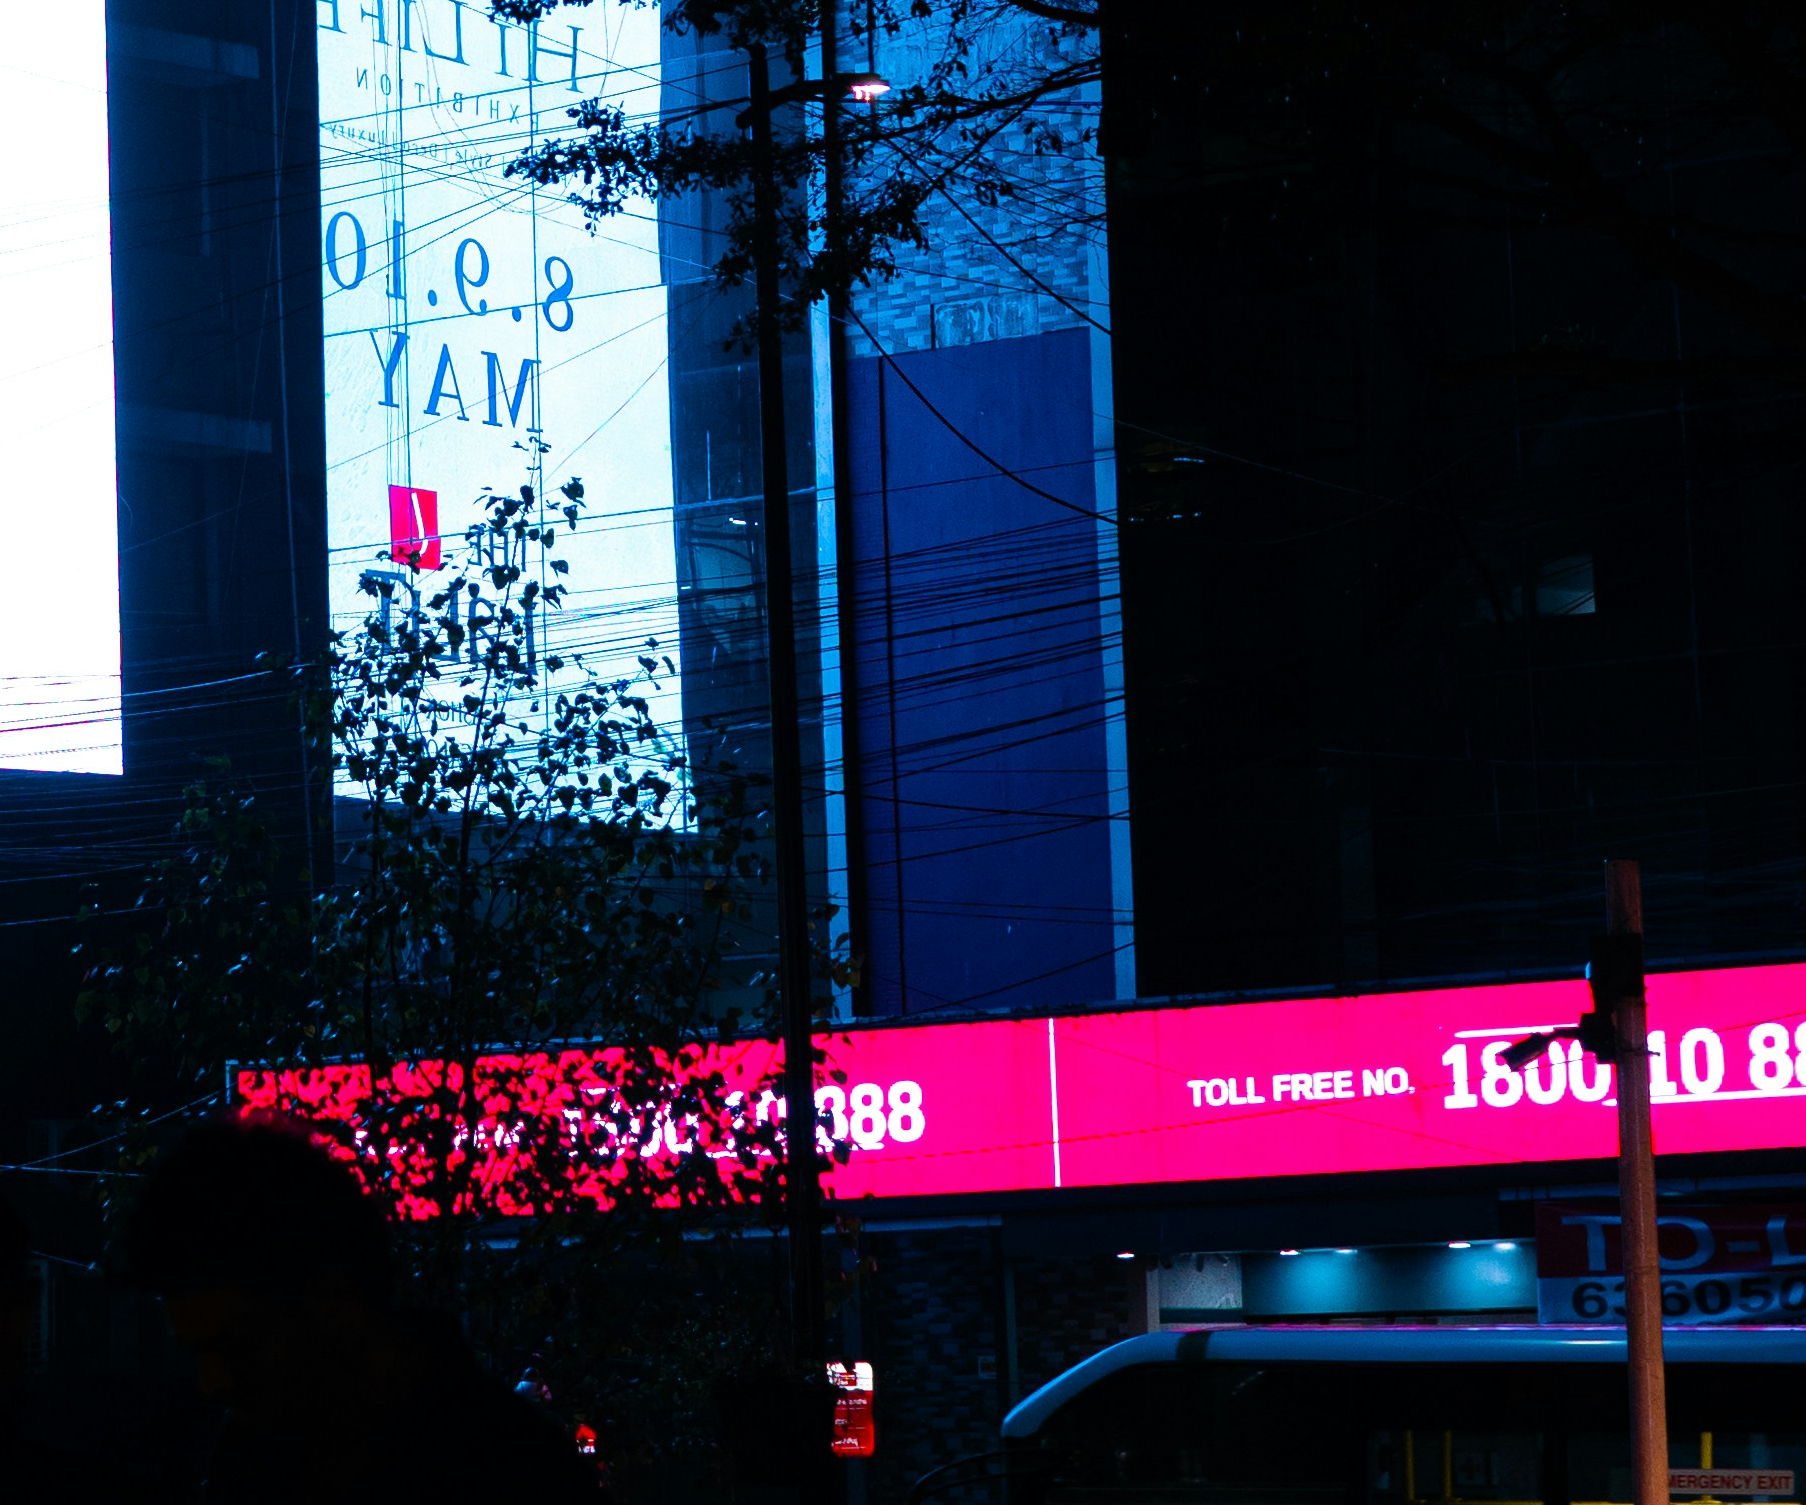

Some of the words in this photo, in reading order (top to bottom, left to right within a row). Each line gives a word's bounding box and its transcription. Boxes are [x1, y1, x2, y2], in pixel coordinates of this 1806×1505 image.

[1187, 1075, 1264, 1108] TOLL
[1273, 1070, 1353, 1102] FREE
[1362, 1065, 1416, 1097] NO.
[1441, 1038, 1612, 1110] 1800
[1647, 1027, 1725, 1096] 10
[1748, 1020, 1806, 1093] 8
[1757, 1475, 1791, 1490] EXIT
